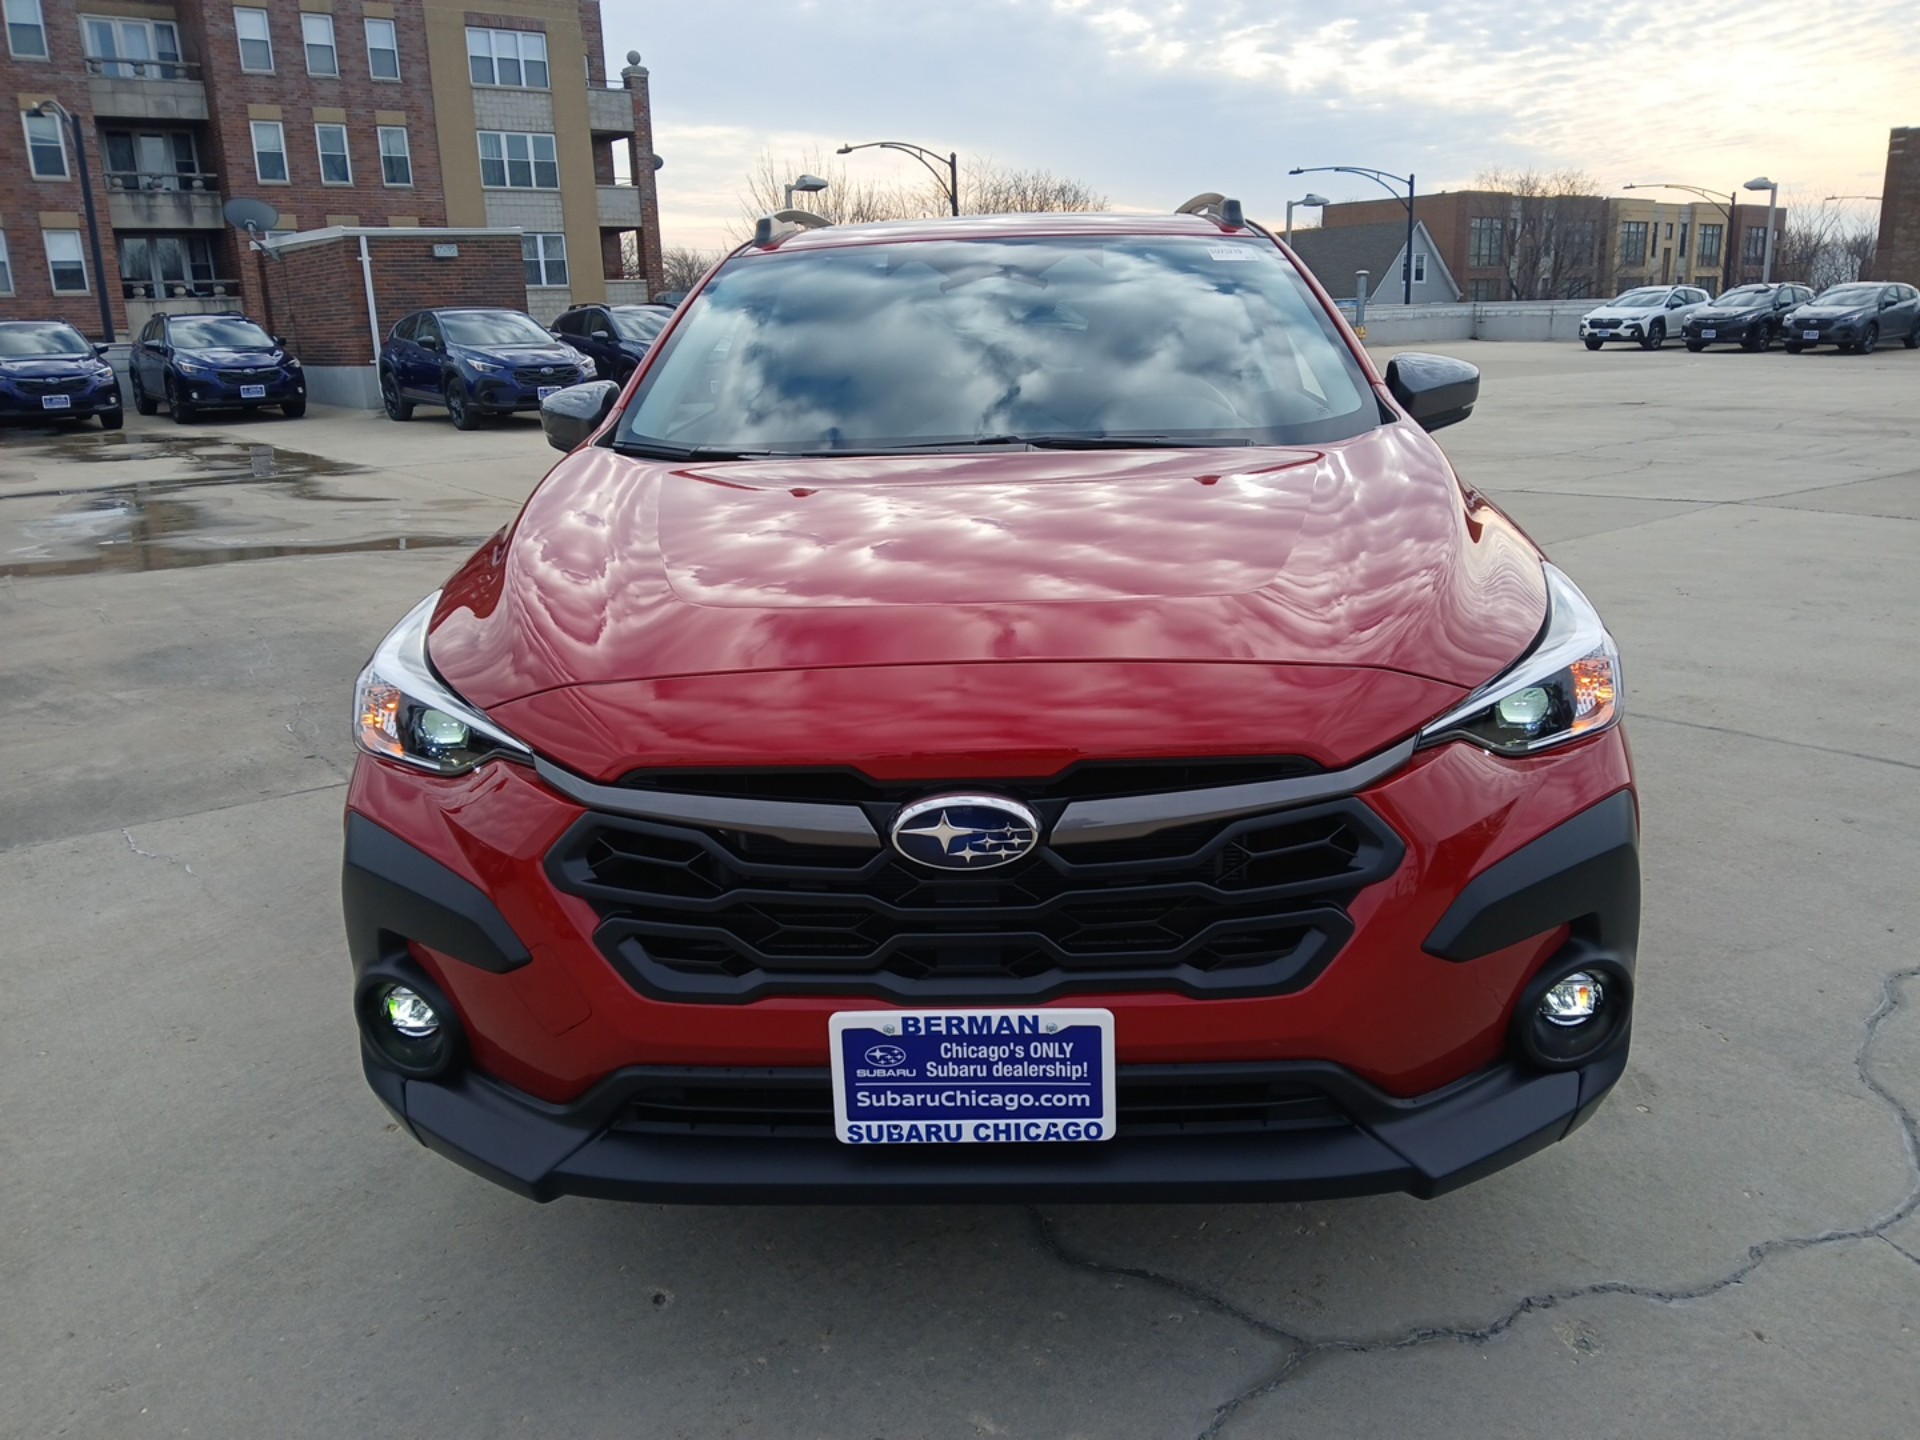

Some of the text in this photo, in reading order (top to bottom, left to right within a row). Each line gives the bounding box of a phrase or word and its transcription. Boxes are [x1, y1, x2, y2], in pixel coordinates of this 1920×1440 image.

[901, 1015, 1040, 1035] BERMAN
[940, 1042, 1074, 1061] Chicago's ONLY
[856, 1068, 917, 1078] SUBARU
[926, 1061, 1088, 1080] Subaru dealership!
[856, 1089, 1091, 1111] SubaruChicago.com
[847, 1121, 1104, 1143] SUBARU CHICAGO
